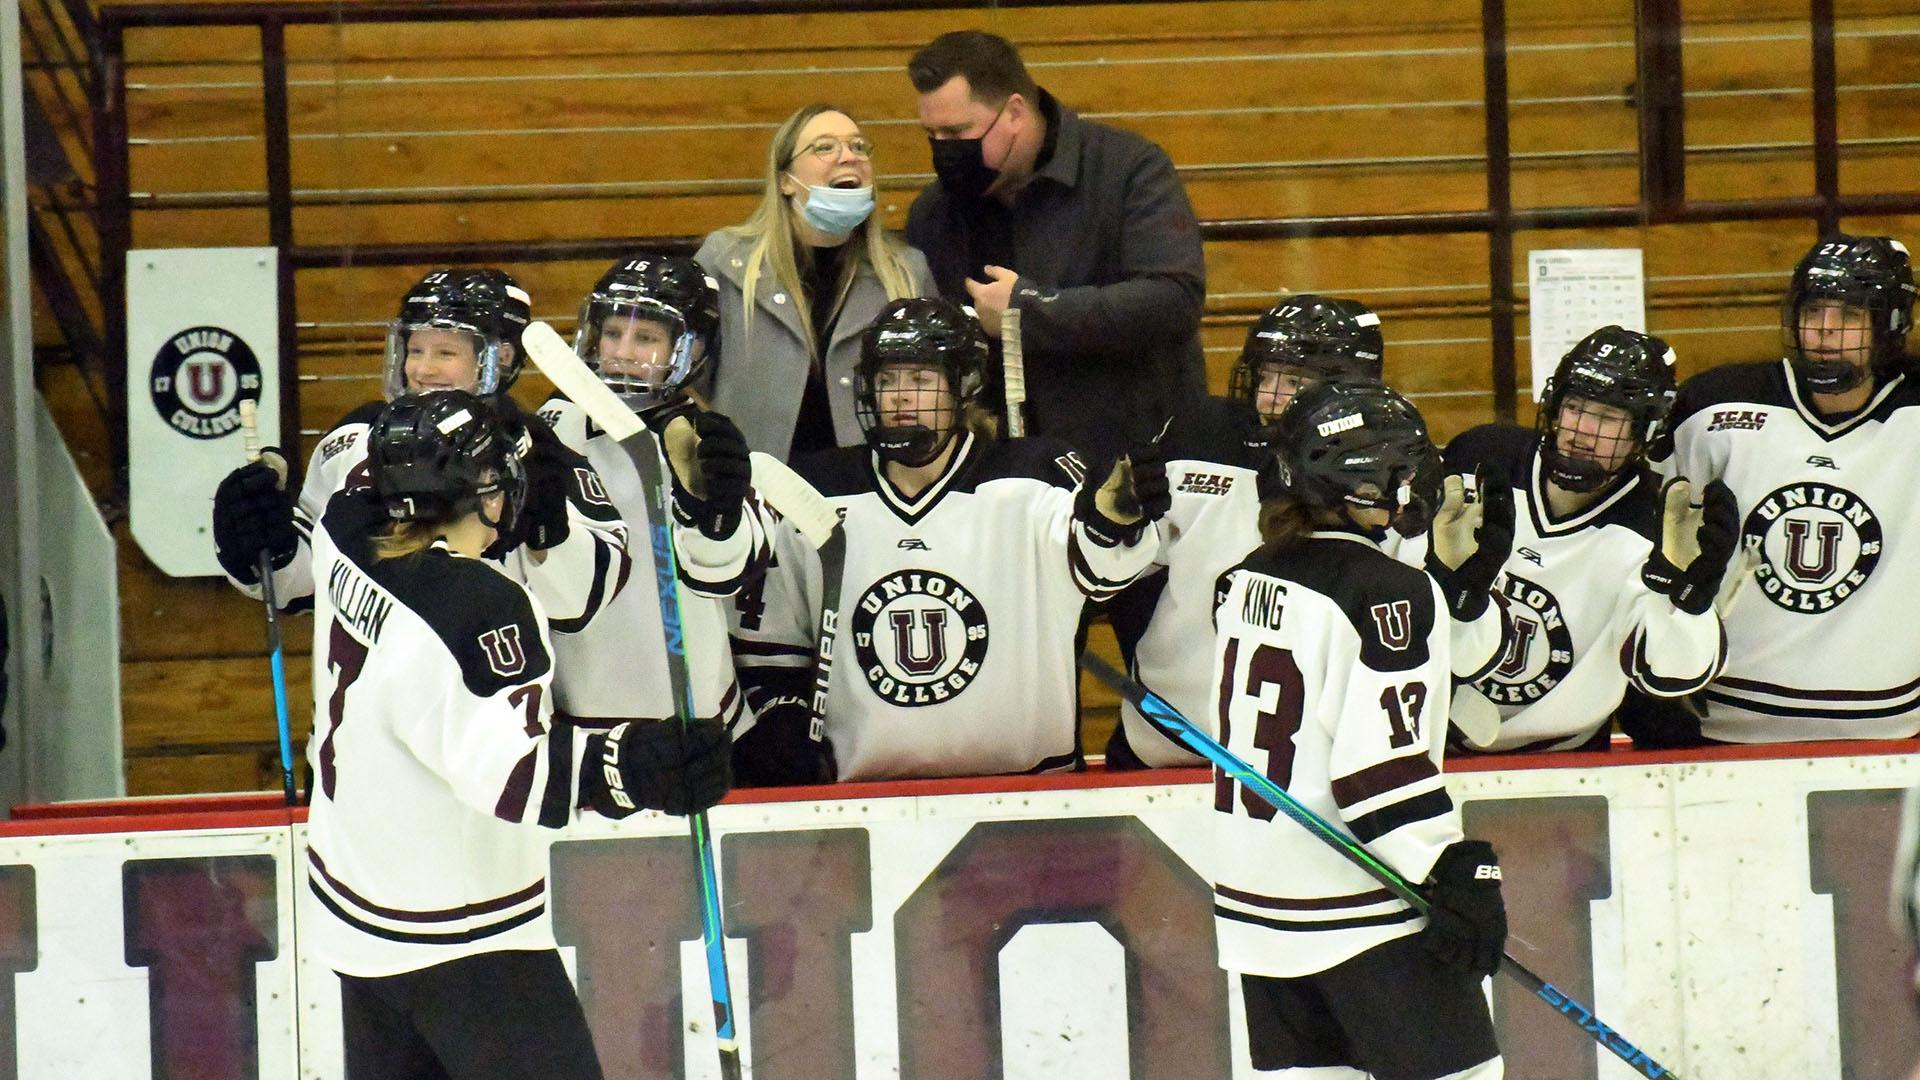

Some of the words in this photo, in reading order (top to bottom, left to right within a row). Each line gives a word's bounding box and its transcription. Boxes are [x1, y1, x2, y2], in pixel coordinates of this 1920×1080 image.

[624, 260, 650, 271] 16
[1820, 243, 1848, 256] 27
[893, 308, 906, 320] 4
[1276, 306, 1302, 318] 17
[174, 330, 233, 354] UNION
[1598, 344, 1613, 357] 9
[187, 361, 225, 405] U
[1317, 412, 1364, 437] UNION
[1712, 411, 1768, 425] ECAC
[1718, 422, 1764, 431] HOCKEY
[1182, 473, 1234, 488] ECAC
[403, 497, 415, 516] 7
[1757, 487, 1871, 527] UNION
[1784, 518, 1843, 583] U
[1862, 541, 1880, 556] 95
[329, 559, 393, 645] KILLIAN
[649, 522, 685, 656] NEXUS
[861, 575, 973, 614] UNION
[1242, 578, 1287, 631] KING
[1755, 563, 1866, 610] COLLEGE
[856, 632, 871, 647] 17
[967, 624, 987, 641] 95
[889, 608, 947, 676] U
[1371, 600, 1411, 651] U
[478, 624, 526, 677] U
[1551, 650, 1571, 663] 95
[809, 608, 839, 743] BAUER
[868, 657, 979, 703] COLLEGE
[508, 684, 546, 739] 7
[1215, 637, 1305, 823] 13
[1380, 681, 1427, 749] 13
[1538, 982, 1665, 1079] NEXUS
